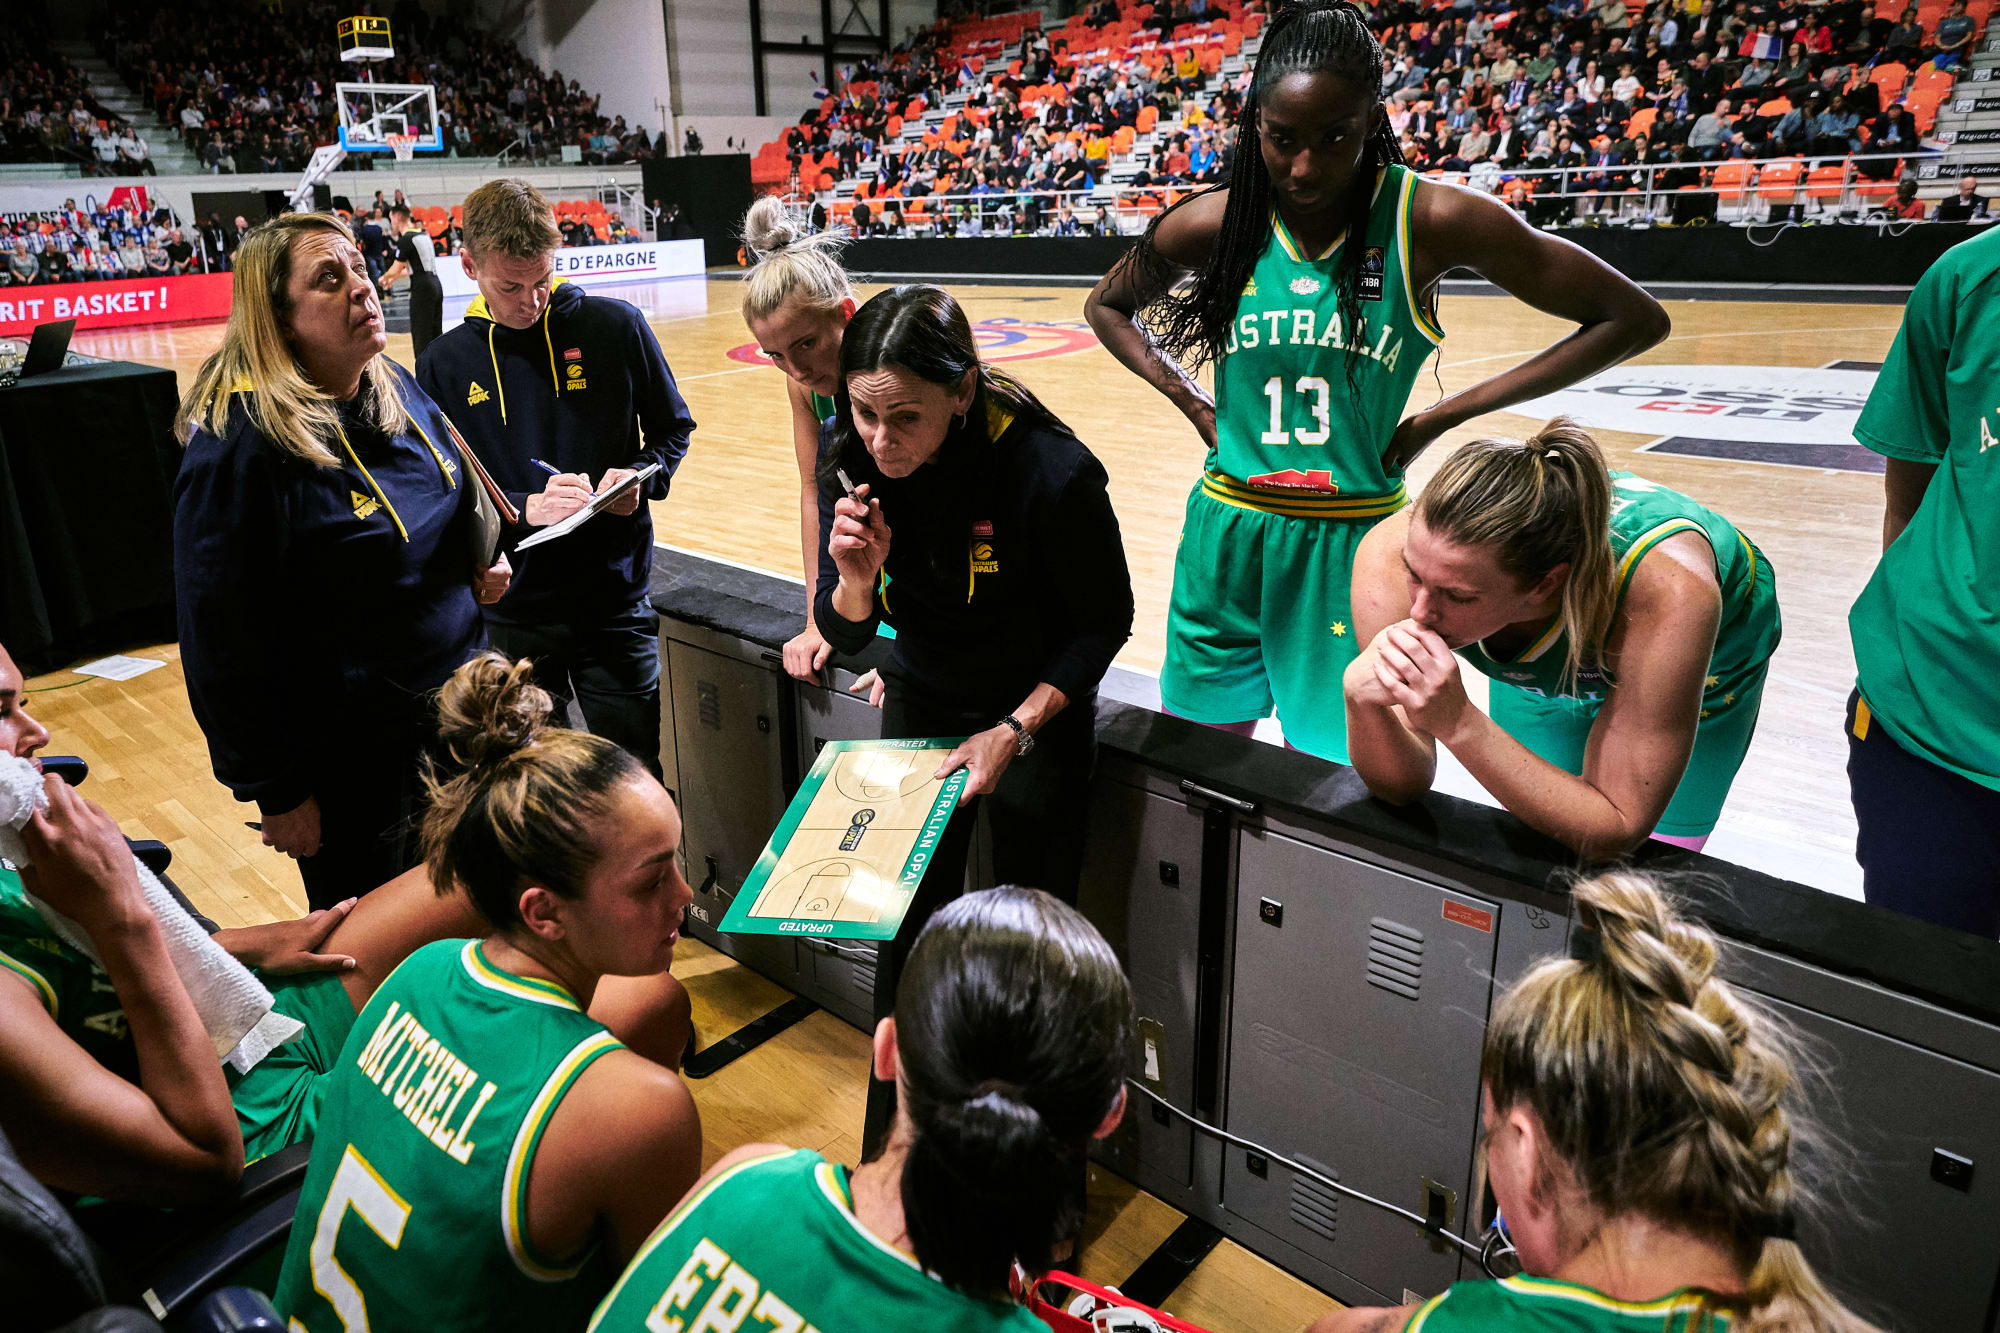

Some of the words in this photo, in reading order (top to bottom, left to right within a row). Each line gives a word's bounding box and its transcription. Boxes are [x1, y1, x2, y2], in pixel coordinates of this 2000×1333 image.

[1940, 168, 1969, 176] Régon
[570, 251, 656, 270] D'EPARGNE
[0, 298, 44, 322] RIT
[1215, 309, 1403, 374] USTRALIA
[567, 382, 587, 391] OPALS
[1261, 376, 1330, 445] 13
[972, 565, 999, 573] OPALS
[919, 767, 966, 848] AUSTRALIAN
[899, 852, 926, 899] OPALS
[778, 921, 834, 933] UPRATED
[357, 1000, 498, 1165] MITCHELL
[288, 1142, 412, 1333] 5
